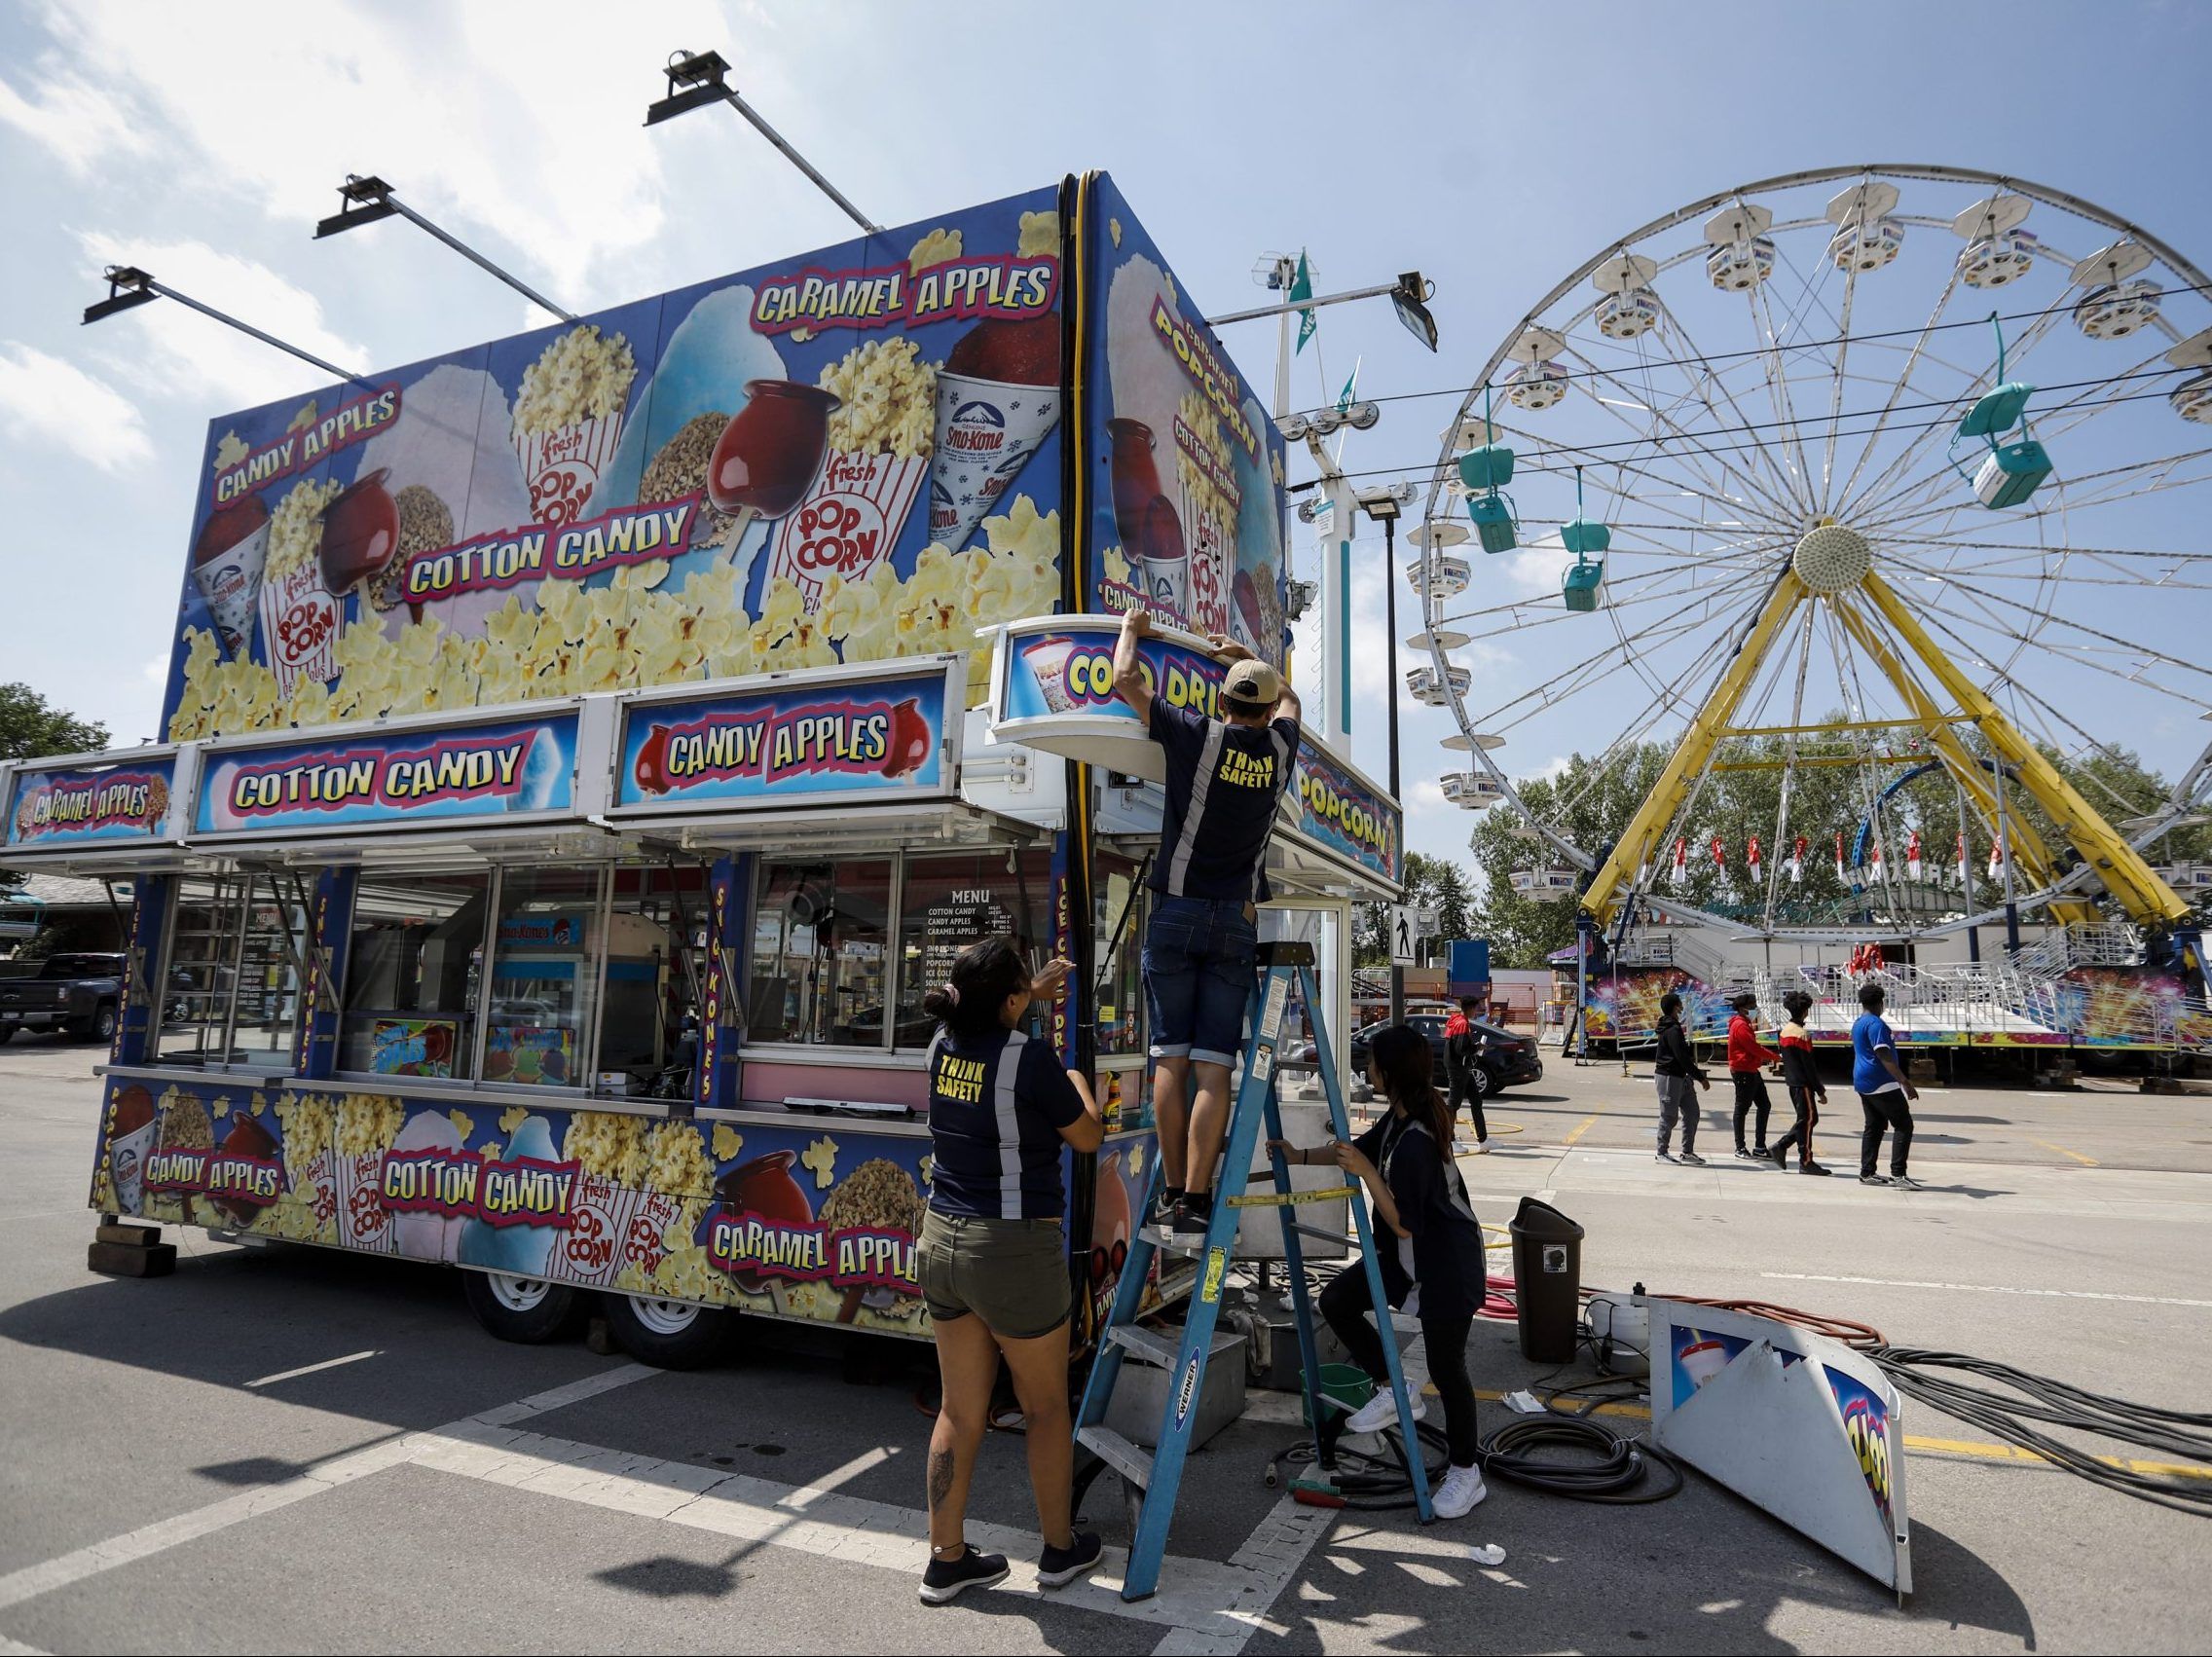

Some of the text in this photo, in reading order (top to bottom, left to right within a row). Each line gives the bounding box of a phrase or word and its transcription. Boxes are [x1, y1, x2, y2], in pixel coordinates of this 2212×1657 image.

[756, 265, 1051, 323] CARAMEL APPLES
[1186, 322, 1235, 395] CARAMEL
[1156, 306, 1256, 456] POPCORN
[216, 390, 396, 503] CANDY APPLES
[542, 432, 583, 464] fresh
[1175, 420, 1241, 502] COTTON CANDY
[529, 471, 576, 511] POP
[827, 456, 876, 491] fresh
[798, 499, 861, 539] POP
[409, 505, 690, 594] COTTON CANDY
[797, 530, 878, 572] CORN
[1192, 559, 1218, 606] POP
[278, 602, 318, 643] POP
[285, 604, 334, 661] CORN
[1070, 655, 1154, 695] COD
[668, 715, 889, 777] CANDY APPLES
[1225, 748, 1273, 773] THINK
[235, 745, 522, 809] COTTON CANDY
[1219, 764, 1272, 788] SAFETY
[34, 784, 148, 825] CARAMEL APPLES
[1298, 763, 1386, 856] POPCORN
[951, 890, 990, 903] MENU
[1058, 878, 1067, 928] ICE
[301, 967, 318, 1069] KONES
[703, 972, 719, 1095] KONES
[937, 1075, 982, 1103] SAFETY
[940, 1054, 986, 1083] THINK
[96, 1086, 120, 1201] POPCORN
[147, 1154, 277, 1197] CANDY APPLES
[355, 1159, 379, 1182] fresh
[385, 1160, 571, 1215] COTTON CANDY
[582, 1176, 611, 1202] fresh
[350, 1187, 380, 1216] POP
[646, 1193, 673, 1219] fresh
[569, 1209, 603, 1241] POP
[629, 1219, 660, 1251] POP
[567, 1238, 612, 1269] CORN
[714, 1221, 918, 1283] CARAMEL APPLE
[1179, 1363, 1197, 1414] WERNER
